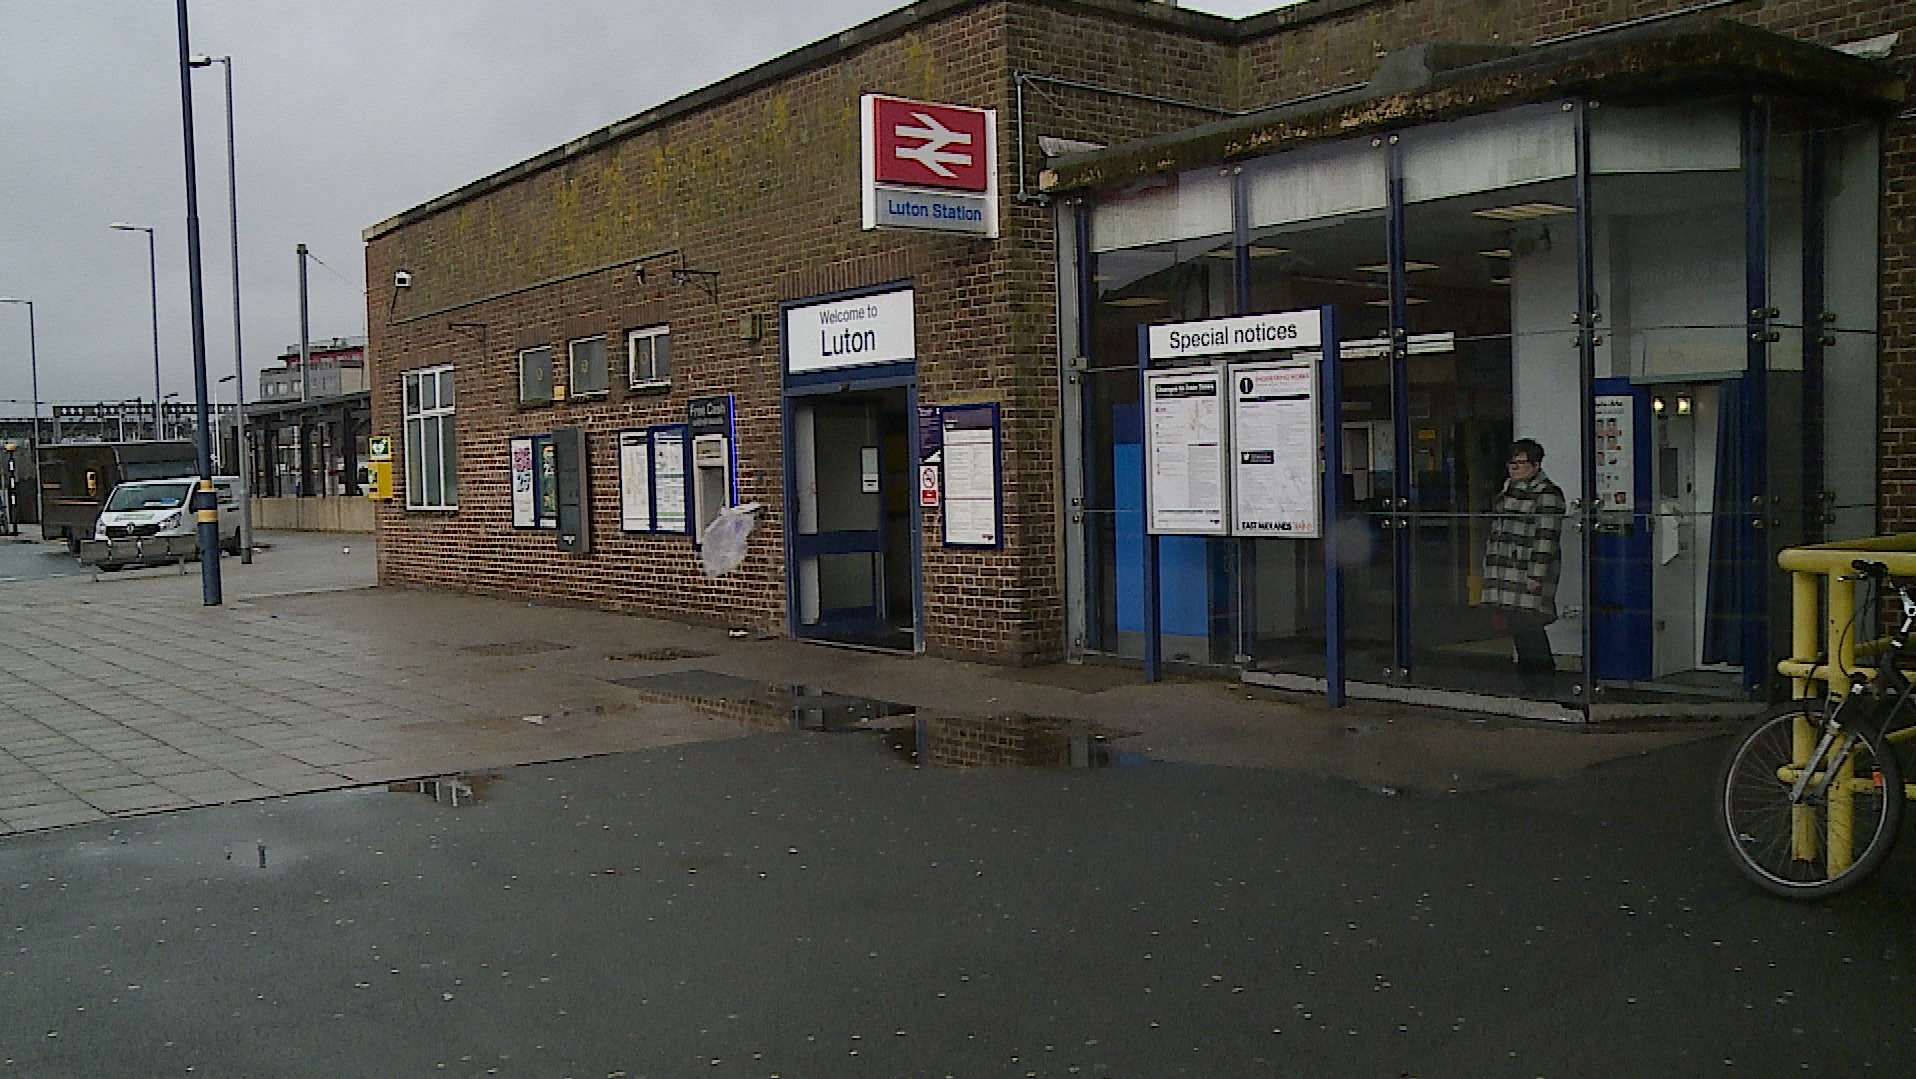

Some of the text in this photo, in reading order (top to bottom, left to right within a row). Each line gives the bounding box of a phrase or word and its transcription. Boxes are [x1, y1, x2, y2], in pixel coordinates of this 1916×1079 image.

[888, 199, 982, 221] Luton Station
[819, 303, 878, 325] Welcome to
[821, 327, 876, 357] Luton
[1169, 321, 1298, 352] Special notices
